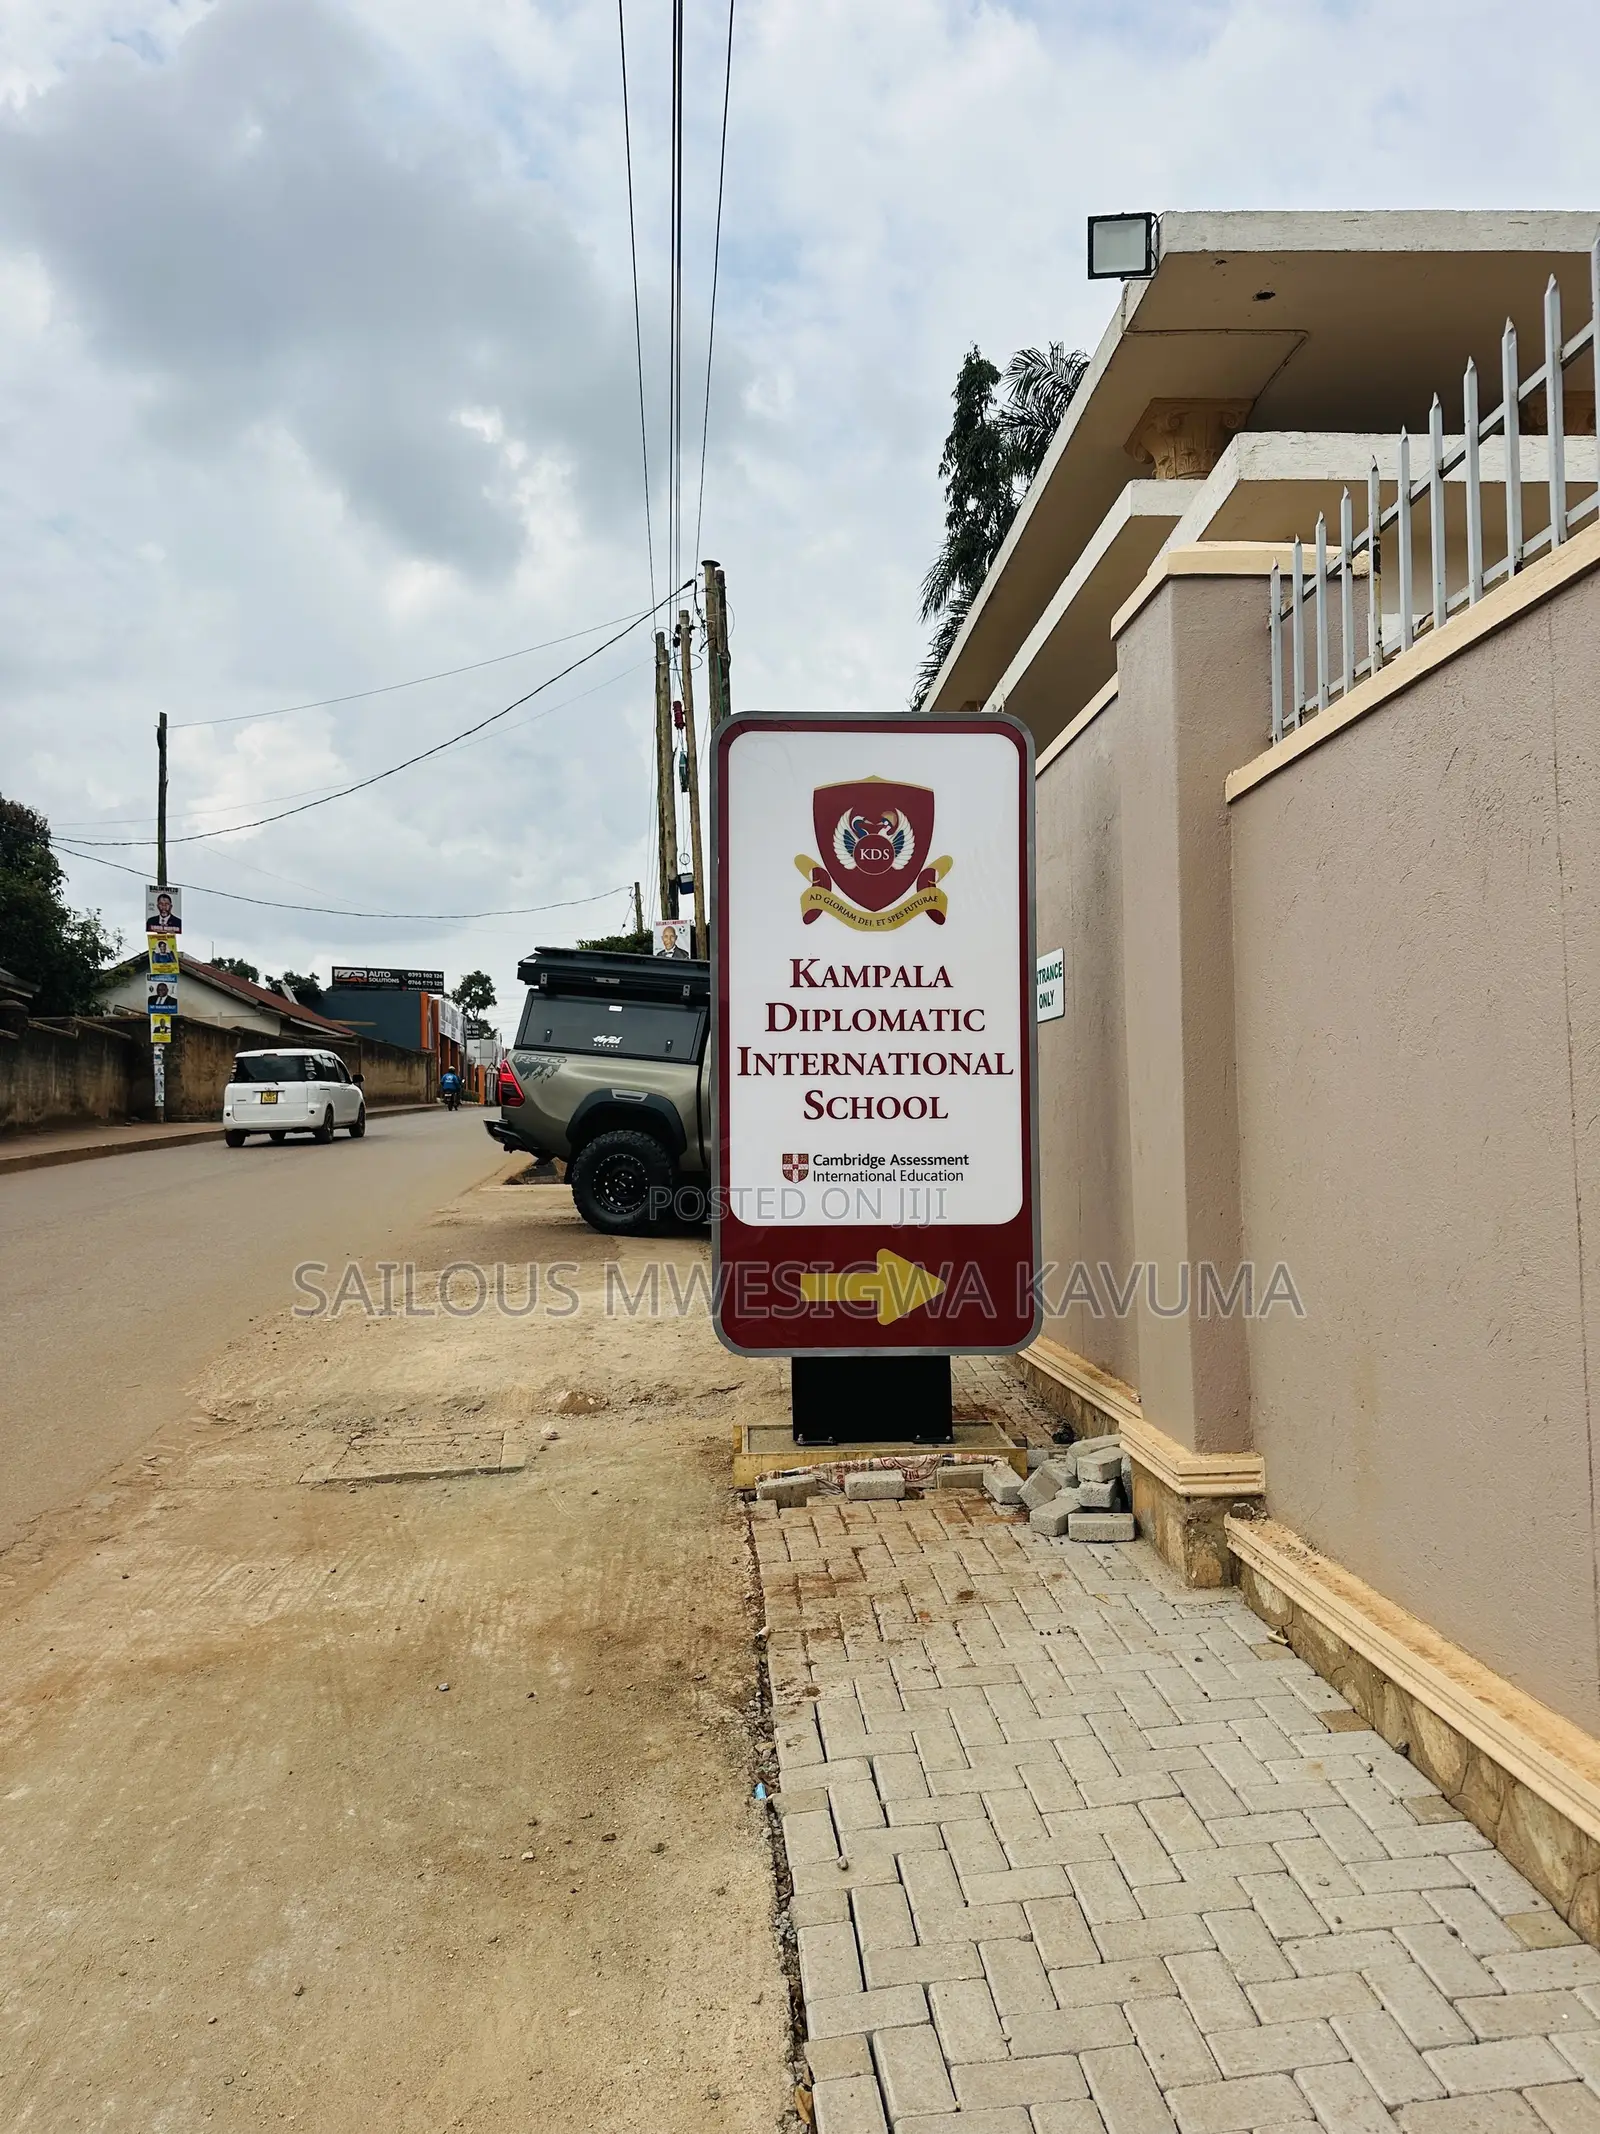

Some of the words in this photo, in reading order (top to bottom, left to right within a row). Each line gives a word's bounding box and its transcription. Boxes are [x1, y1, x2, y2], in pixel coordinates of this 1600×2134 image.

[860, 848, 890, 860] KDS
[809, 893, 822, 902] AD
[823, 896, 857, 922] GLORIAM
[876, 918, 886, 926] ET
[887, 912, 905, 924] SPES
[904, 895, 939, 914] FUTURAE
[368, 970, 391, 978] AUTO
[789, 958, 954, 988] KAMPALA
[1038, 989, 1055, 1009] ONLY
[764, 1002, 986, 1032] DIPLOMATIC
[515, 1054, 568, 1064] ROCCO
[736, 1047, 1014, 1076] INTERNATIONAL
[803, 1089, 949, 1120] SCHOOL
[812, 1153, 886, 1169] Cambridge
[889, 1154, 970, 1166] Assessment
[813, 1169, 897, 1182] International
[899, 1169, 964, 1182] Education
